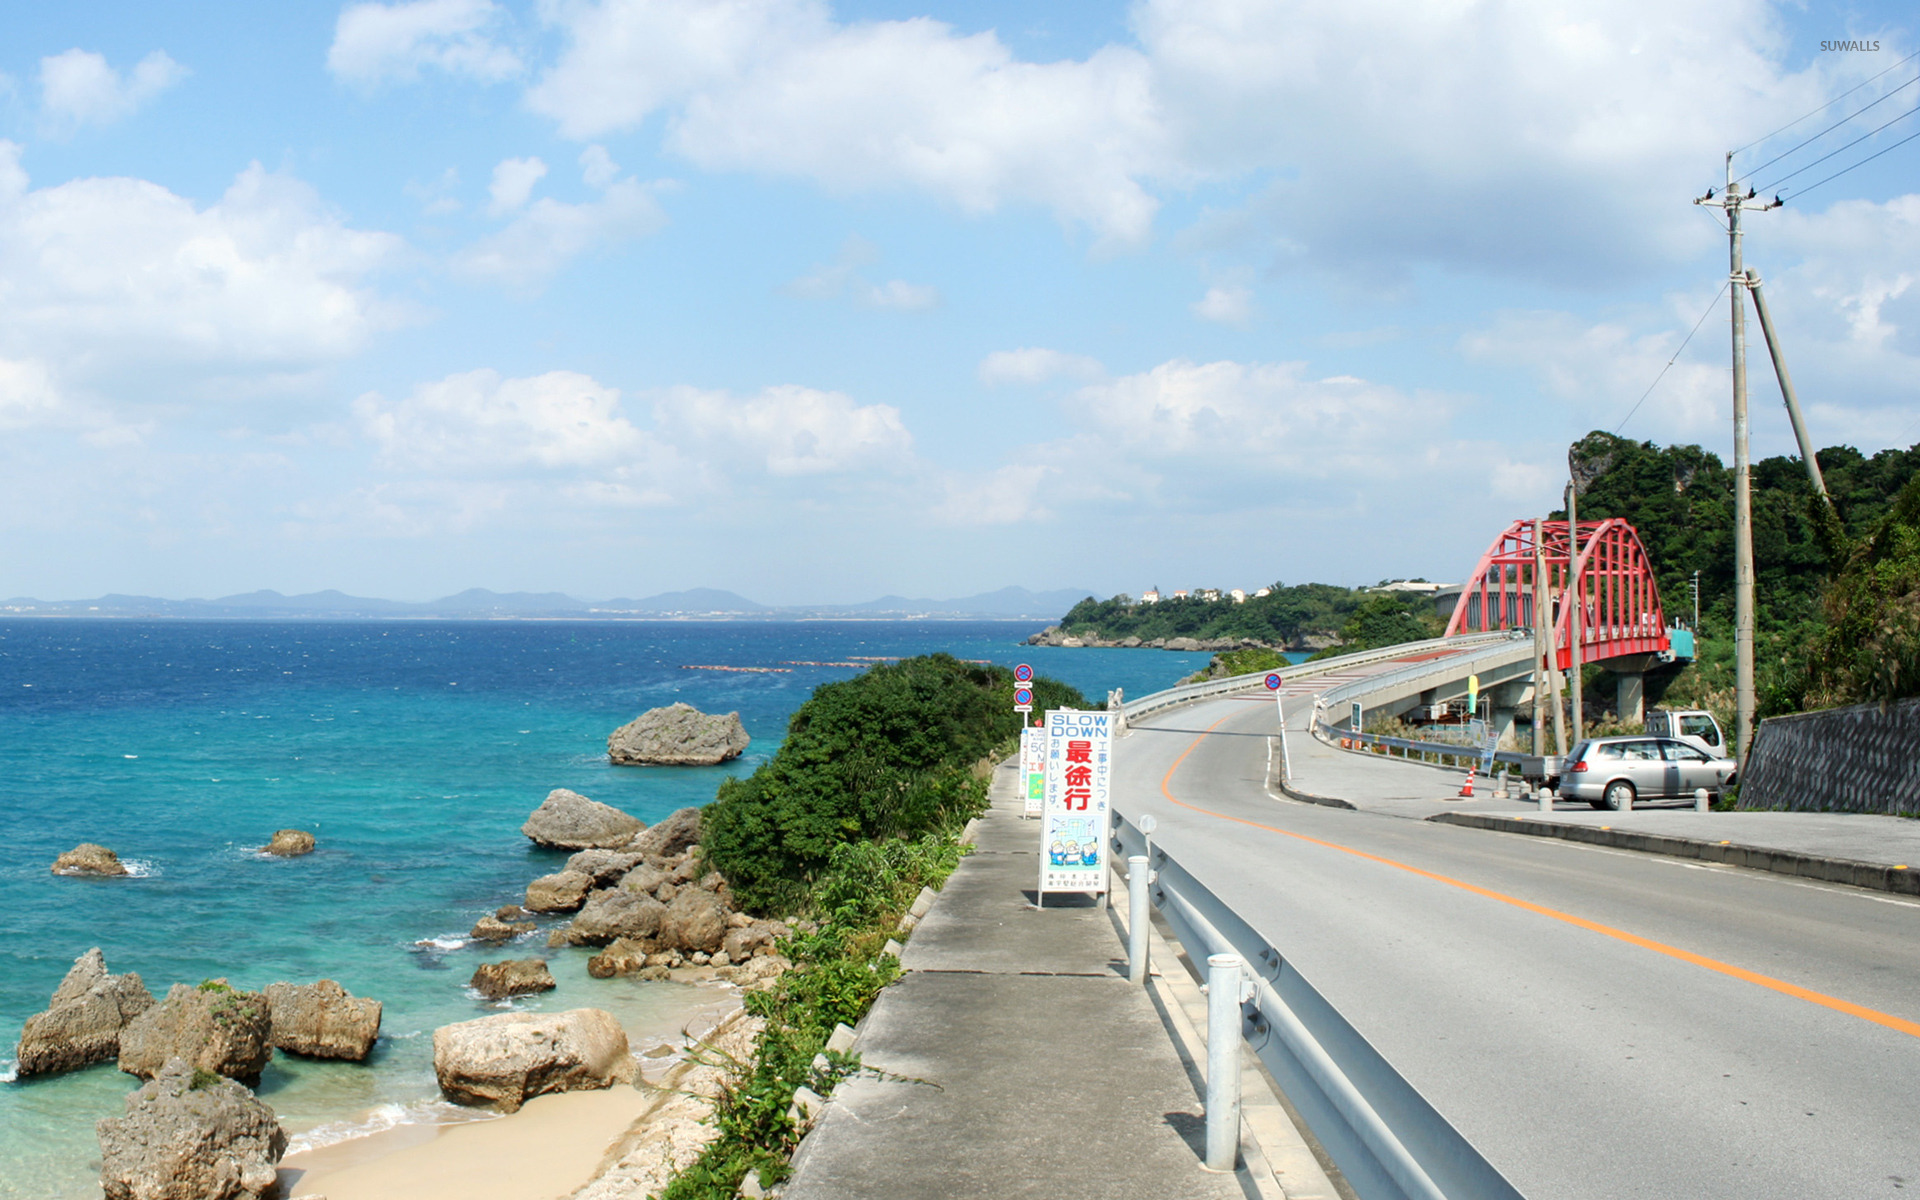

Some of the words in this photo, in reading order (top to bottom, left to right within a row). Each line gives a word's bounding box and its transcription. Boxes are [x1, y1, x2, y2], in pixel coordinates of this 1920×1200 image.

[1051, 726, 1108, 738] DOWN
[1052, 715, 1108, 726] SLOW
[1063, 740, 1093, 811] 最徐行
[1097, 741, 1108, 812] 工事中につき
